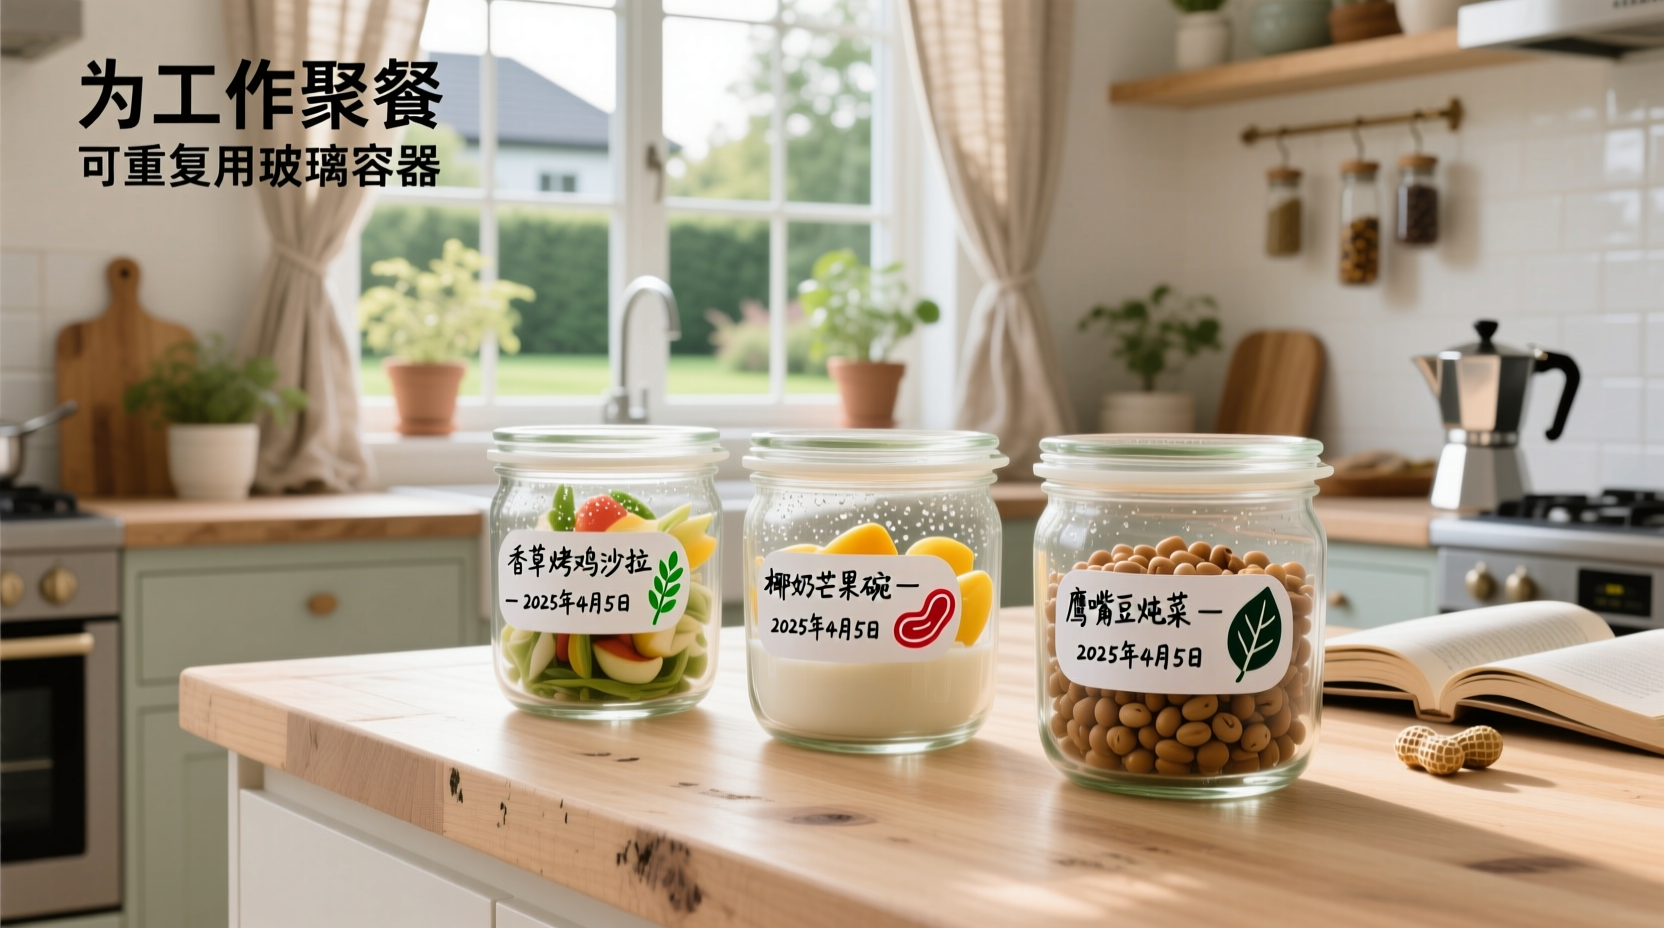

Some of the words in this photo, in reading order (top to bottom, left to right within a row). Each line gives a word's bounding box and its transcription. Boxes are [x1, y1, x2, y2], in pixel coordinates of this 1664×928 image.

[507, 543, 653, 578] 香草烤鸡沙拉
[764, 567, 892, 601] 椰奶芒果碗
[523, 588, 630, 616] 2025年4月5日
[1065, 586, 1191, 628] 鹰嘴豆炖菜
[770, 612, 879, 641] 2025年4月5日
[1076, 640, 1202, 670] 2025年4月5日
